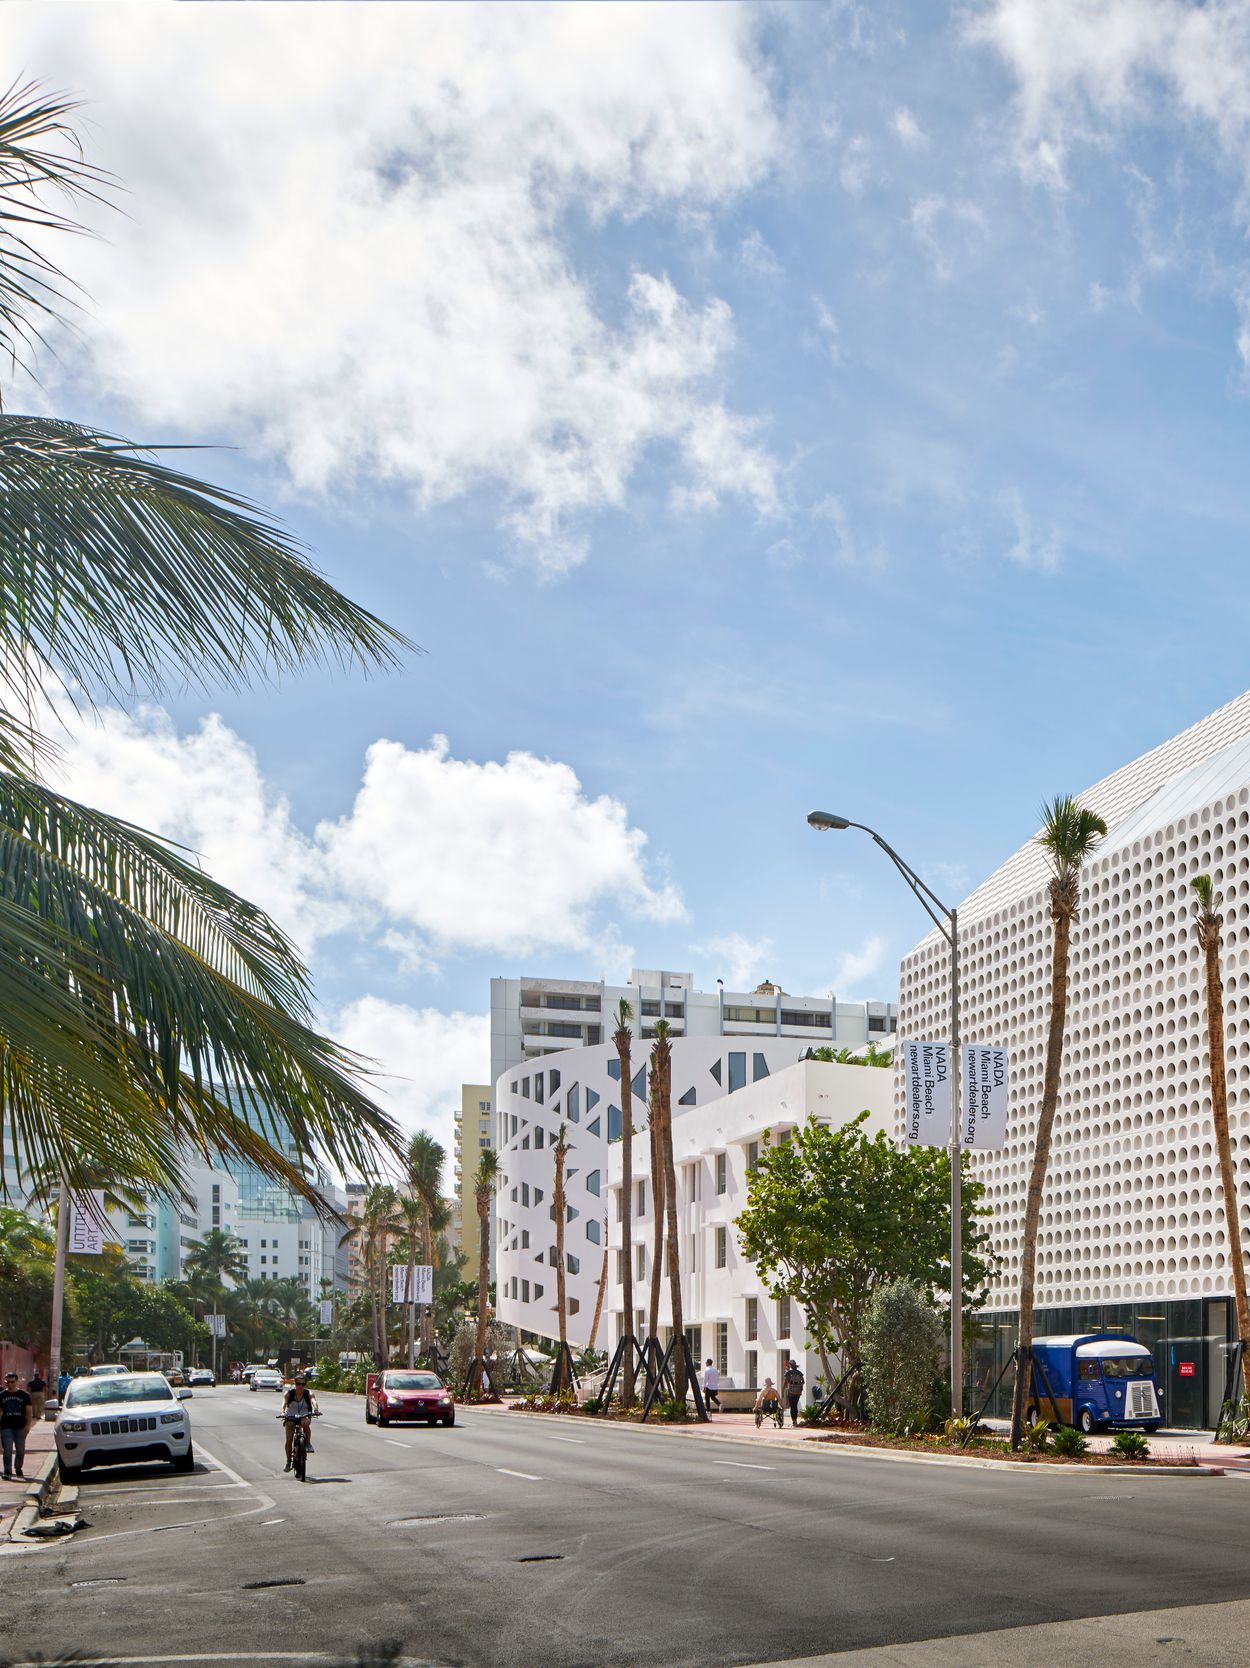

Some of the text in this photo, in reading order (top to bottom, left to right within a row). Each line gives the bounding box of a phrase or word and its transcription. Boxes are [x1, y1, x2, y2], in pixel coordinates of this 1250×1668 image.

[908, 1045, 922, 1140] newartdealers.org
[922, 1046, 935, 1115] Miami Beach
[935, 1046, 947, 1082] NADA
[964, 1049, 979, 1144] newartdealers.org
[980, 1050, 992, 1119] Miami Beach
[993, 1051, 1004, 1087] NADA
